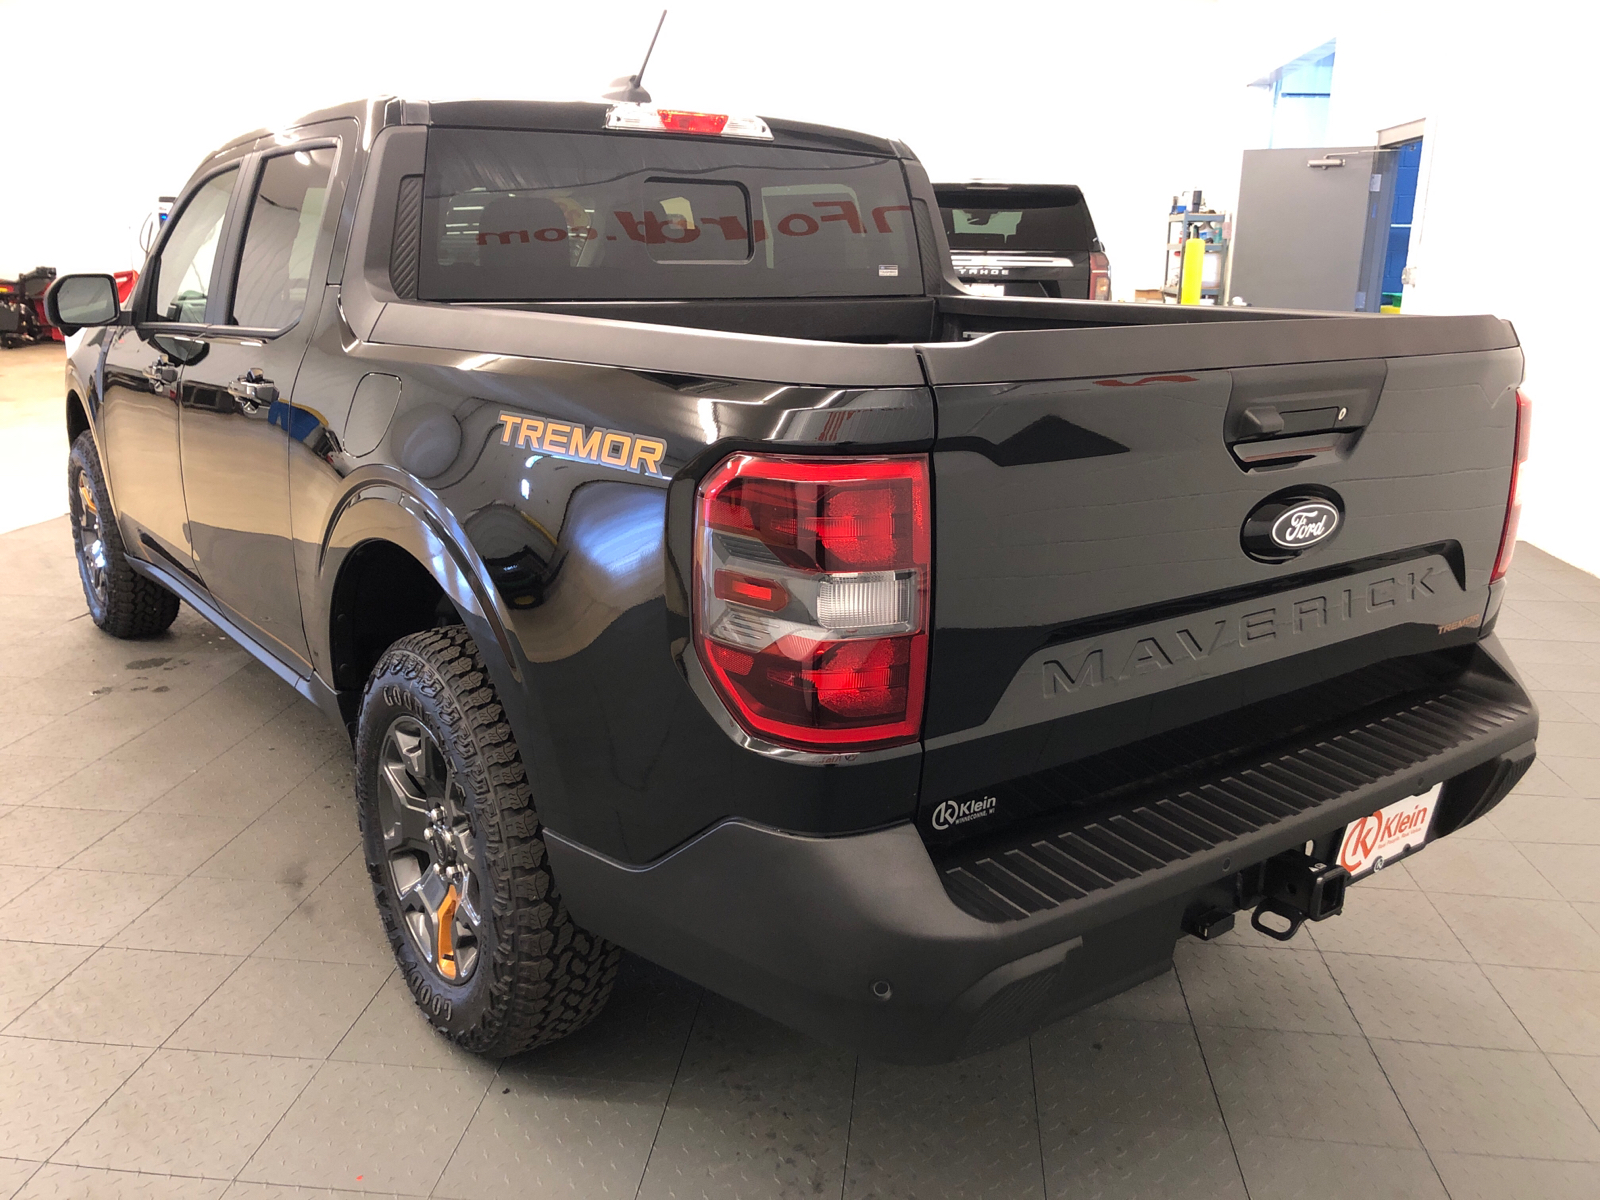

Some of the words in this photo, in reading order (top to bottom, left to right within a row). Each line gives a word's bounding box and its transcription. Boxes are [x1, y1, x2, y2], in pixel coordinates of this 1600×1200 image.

[958, 268, 1010, 276] TAHOE
[498, 412, 666, 476] TREMOR
[1285, 510, 1327, 541] Ford
[1042, 567, 1435, 699] MAVERICK
[1437, 613, 1480, 635] TREMOR
[959, 796, 997, 817] Klein
[1380, 805, 1427, 842] Klein
